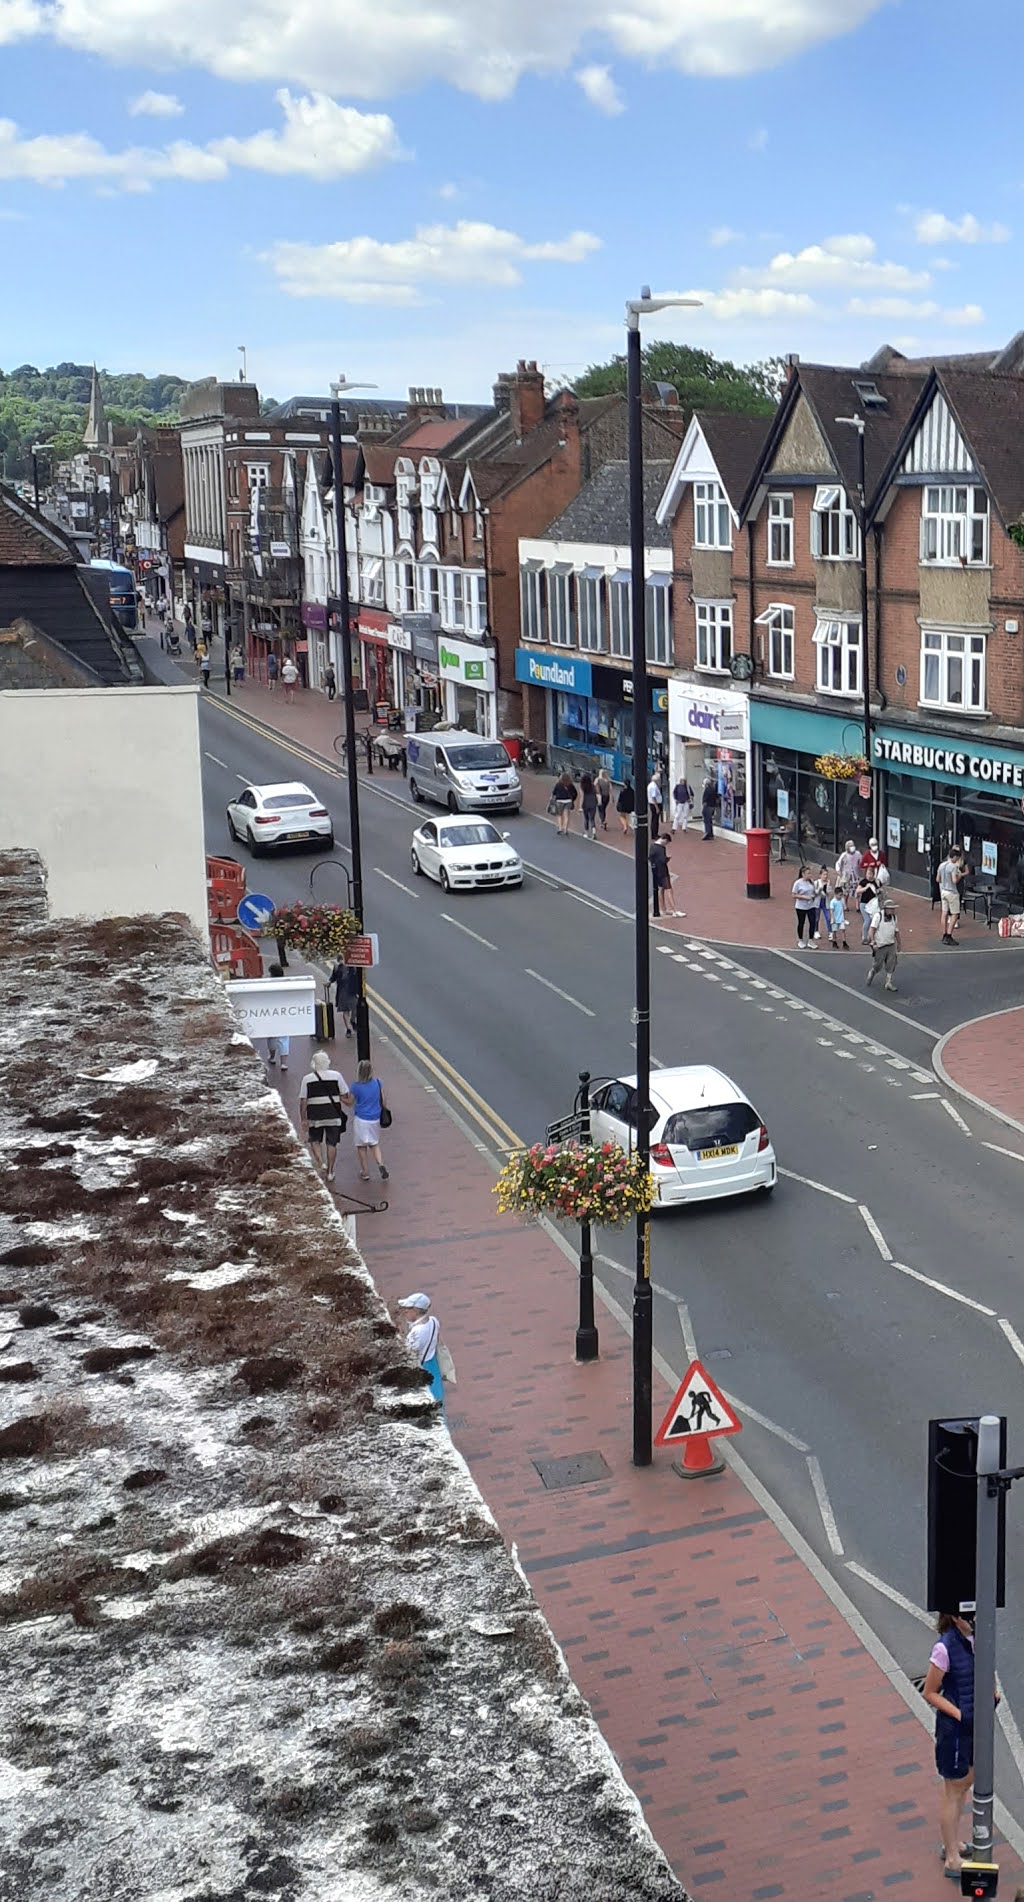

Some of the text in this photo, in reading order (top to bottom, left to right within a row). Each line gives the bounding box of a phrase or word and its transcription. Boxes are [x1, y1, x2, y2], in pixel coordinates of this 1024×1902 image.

[529, 658, 575, 688] Poundland
[874, 737, 966, 776] STARBUCKS
[238, 1005, 312, 1019] ONMARCHE
[702, 1150, 720, 1160] HX14
